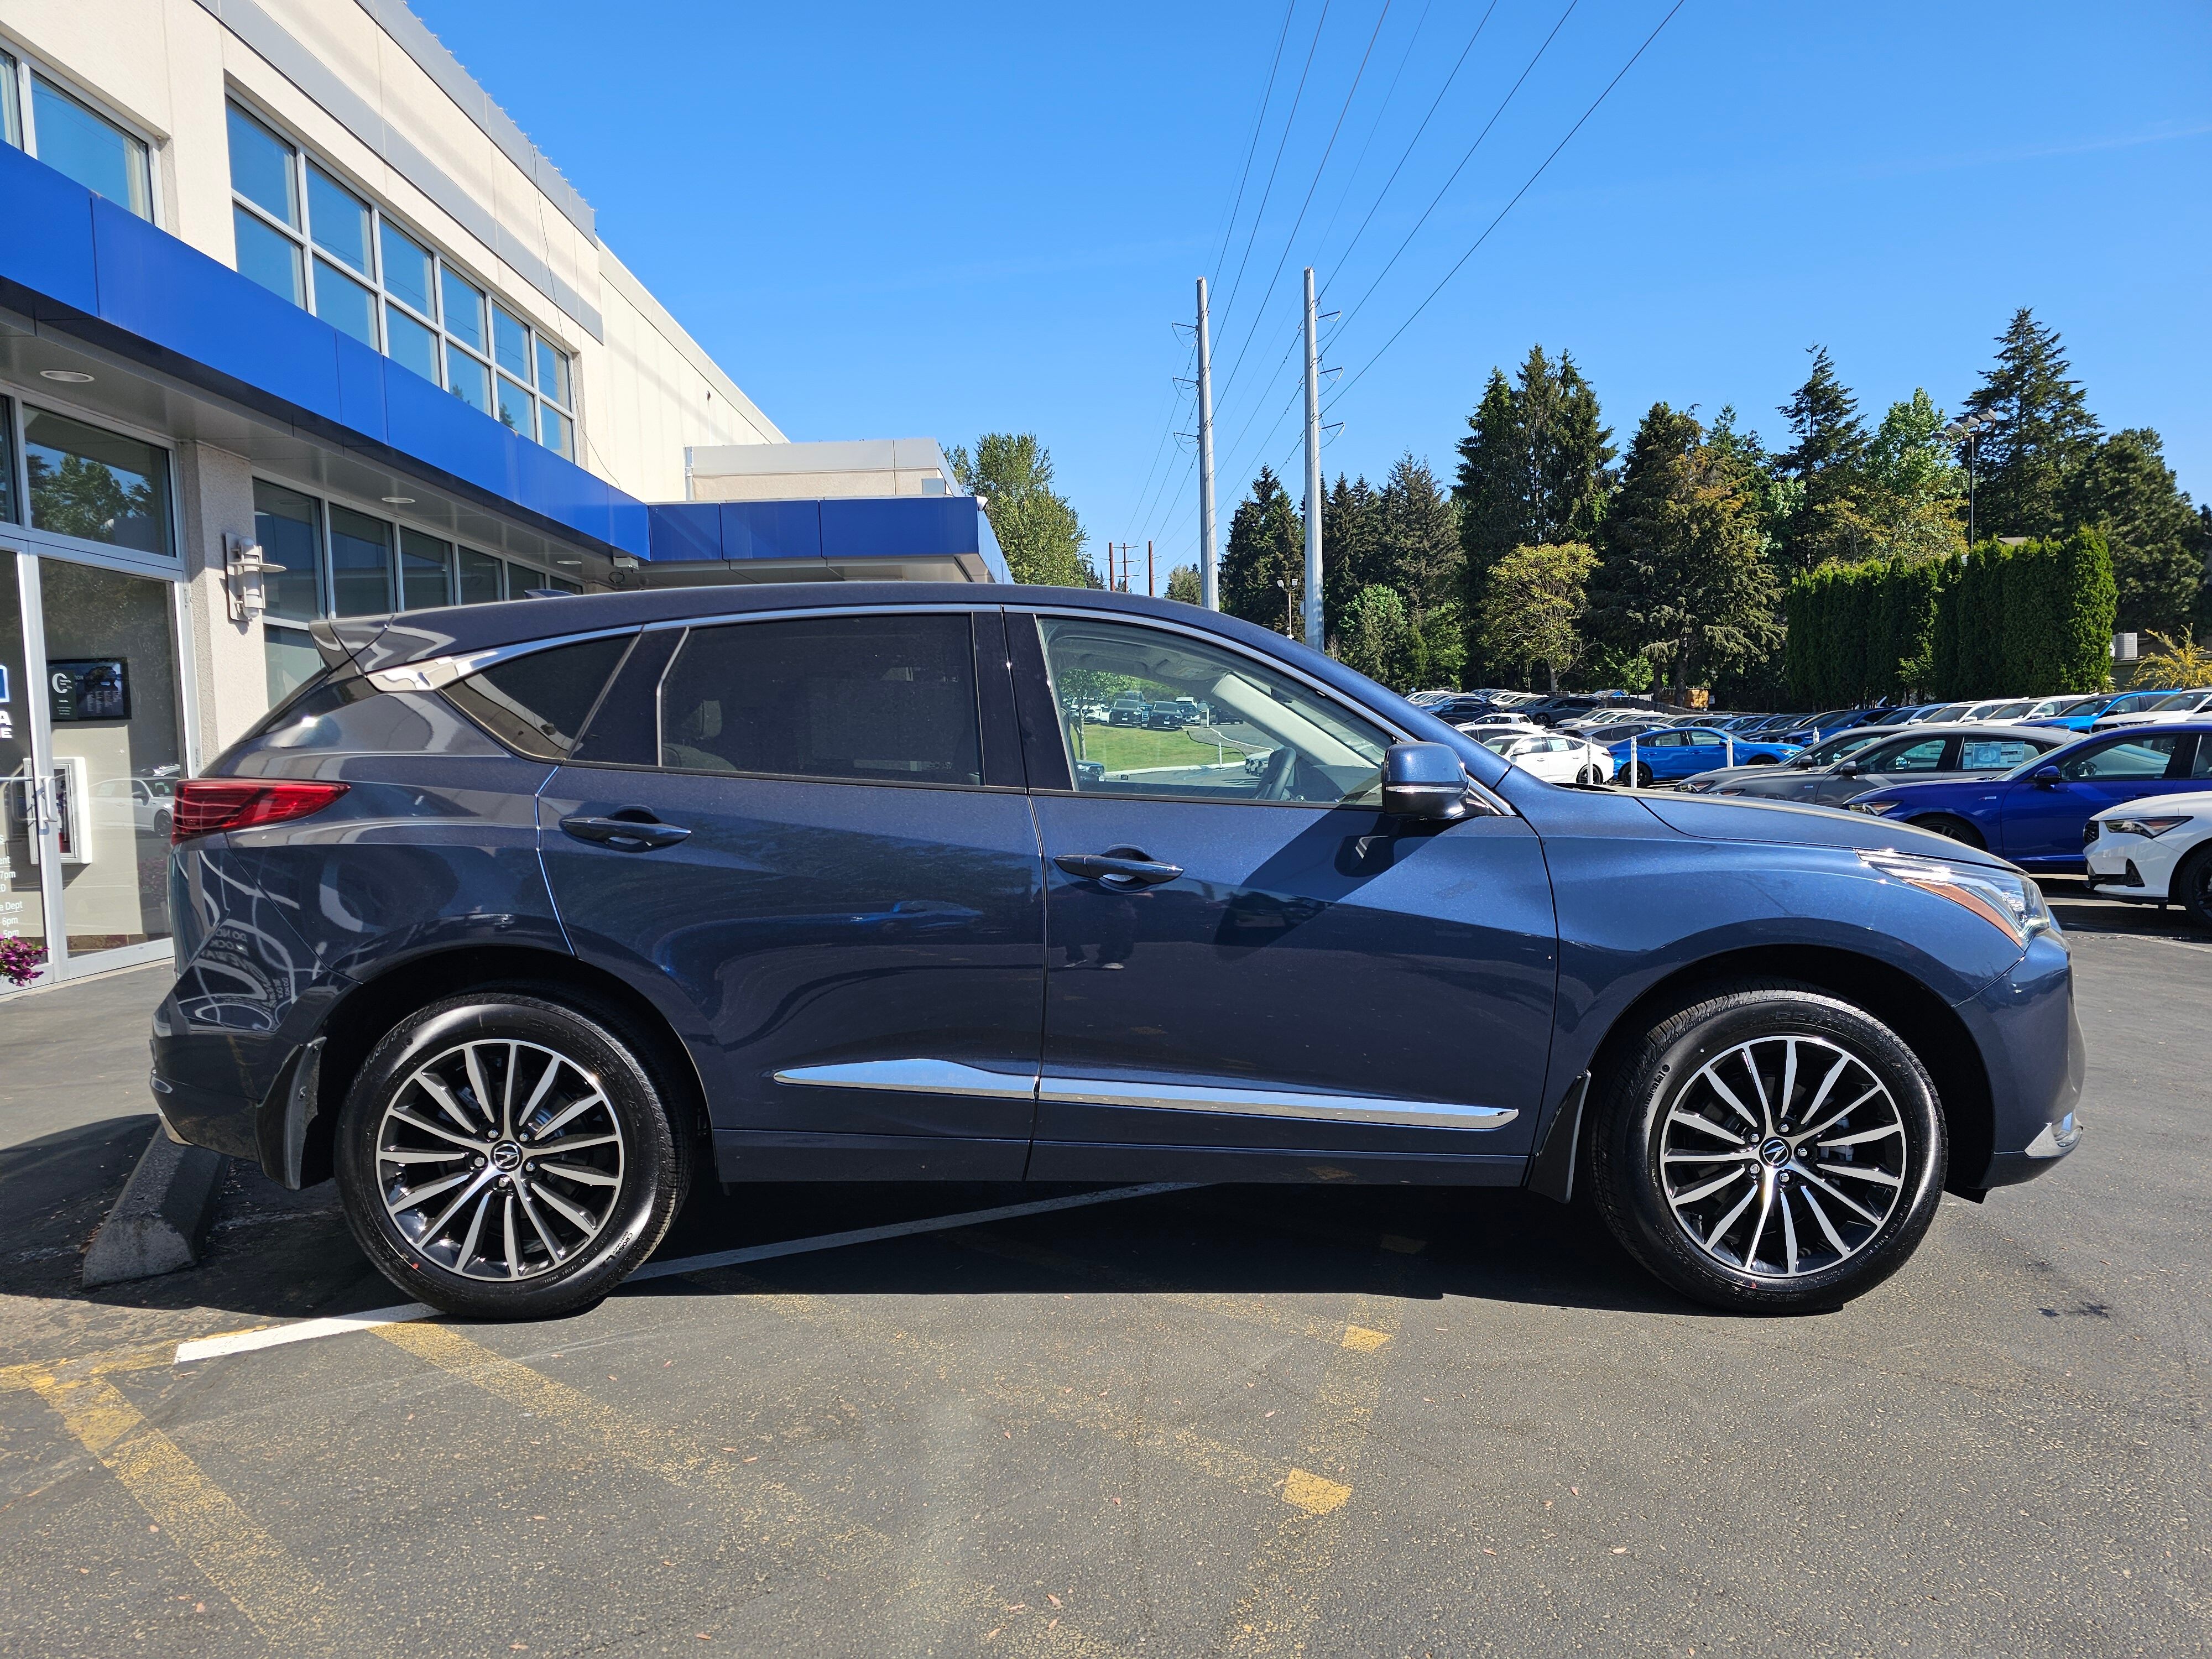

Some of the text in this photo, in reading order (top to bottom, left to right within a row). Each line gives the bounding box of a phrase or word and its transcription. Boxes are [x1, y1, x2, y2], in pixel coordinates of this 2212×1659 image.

[0, 870, 16, 881] 7pm
[5, 900, 23, 911] Dept
[2, 917, 18, 927] 6pm
